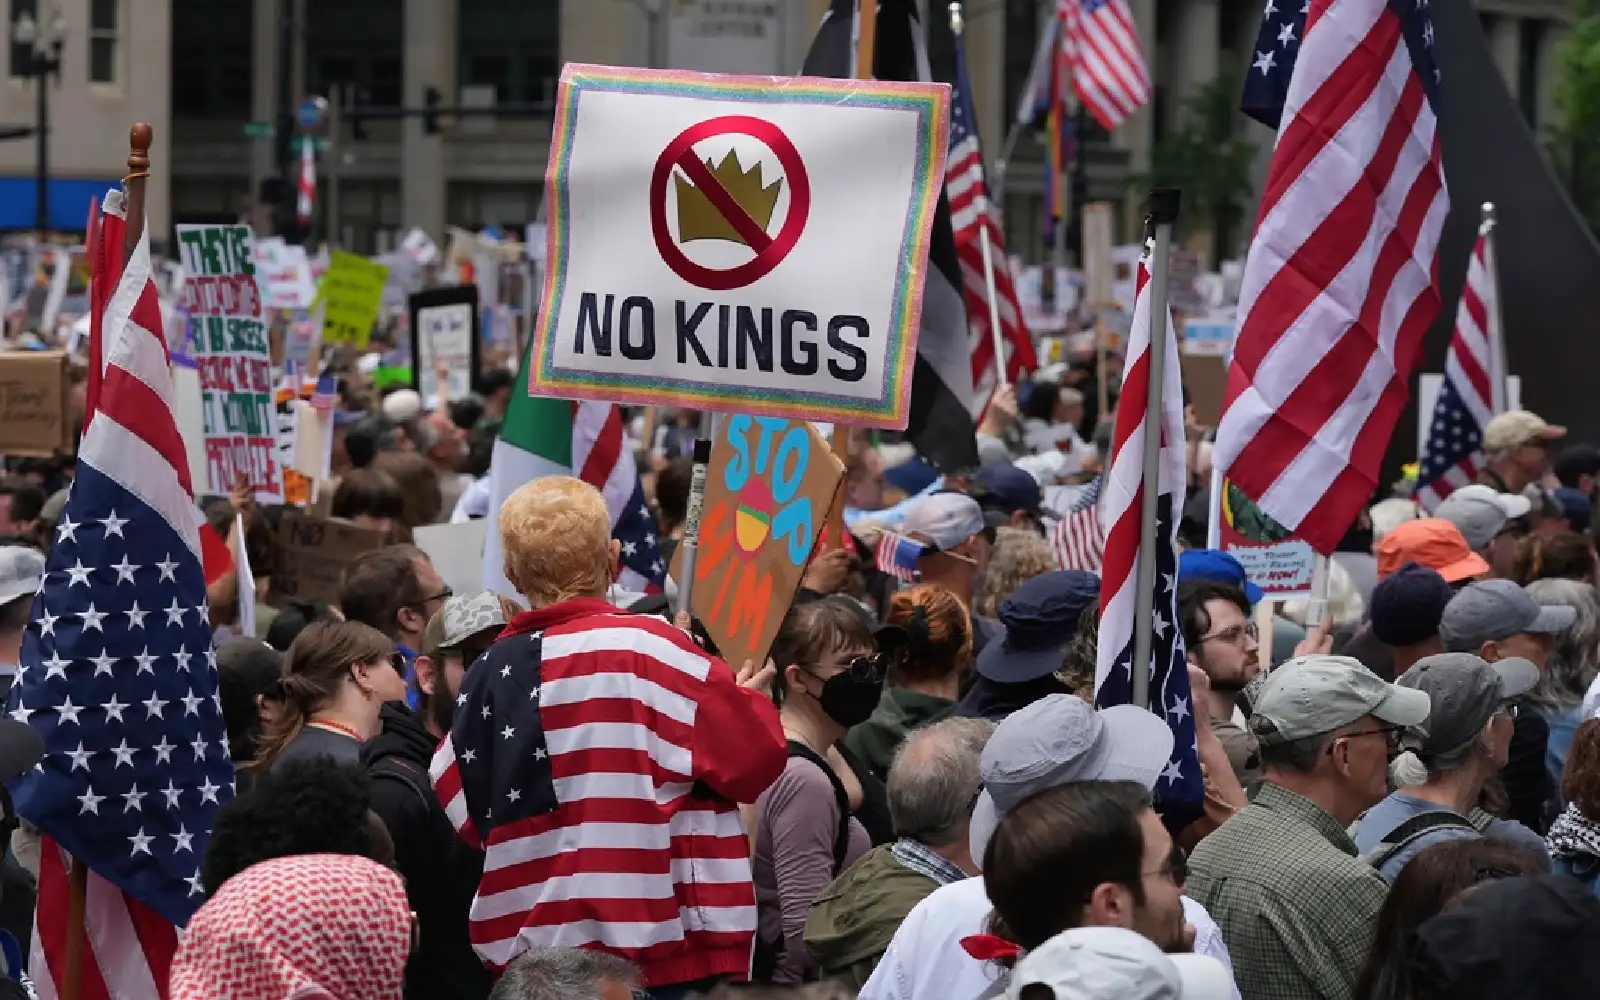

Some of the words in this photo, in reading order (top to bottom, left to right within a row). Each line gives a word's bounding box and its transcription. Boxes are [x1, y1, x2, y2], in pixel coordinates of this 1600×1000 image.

[573, 292, 656, 361] NO
[674, 299, 871, 382] KINGS
[724, 413, 813, 566] STOP
[696, 502, 774, 653] HIM
